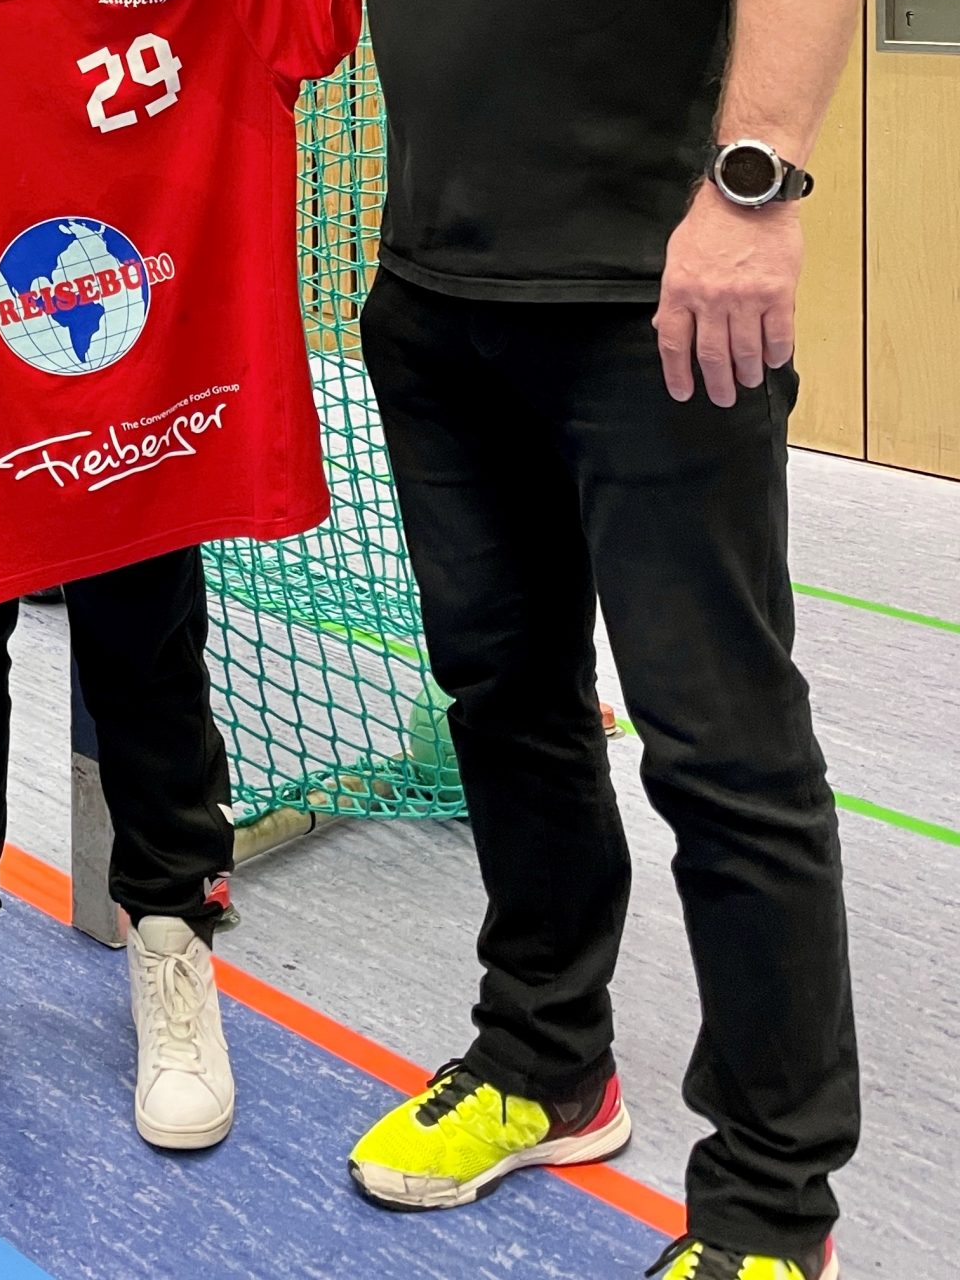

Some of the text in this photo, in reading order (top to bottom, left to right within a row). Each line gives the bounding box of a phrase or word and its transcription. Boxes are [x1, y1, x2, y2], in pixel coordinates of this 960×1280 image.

[75, 32, 183, 134] 29
[121, 383, 240, 431] The Convenience Food Group
